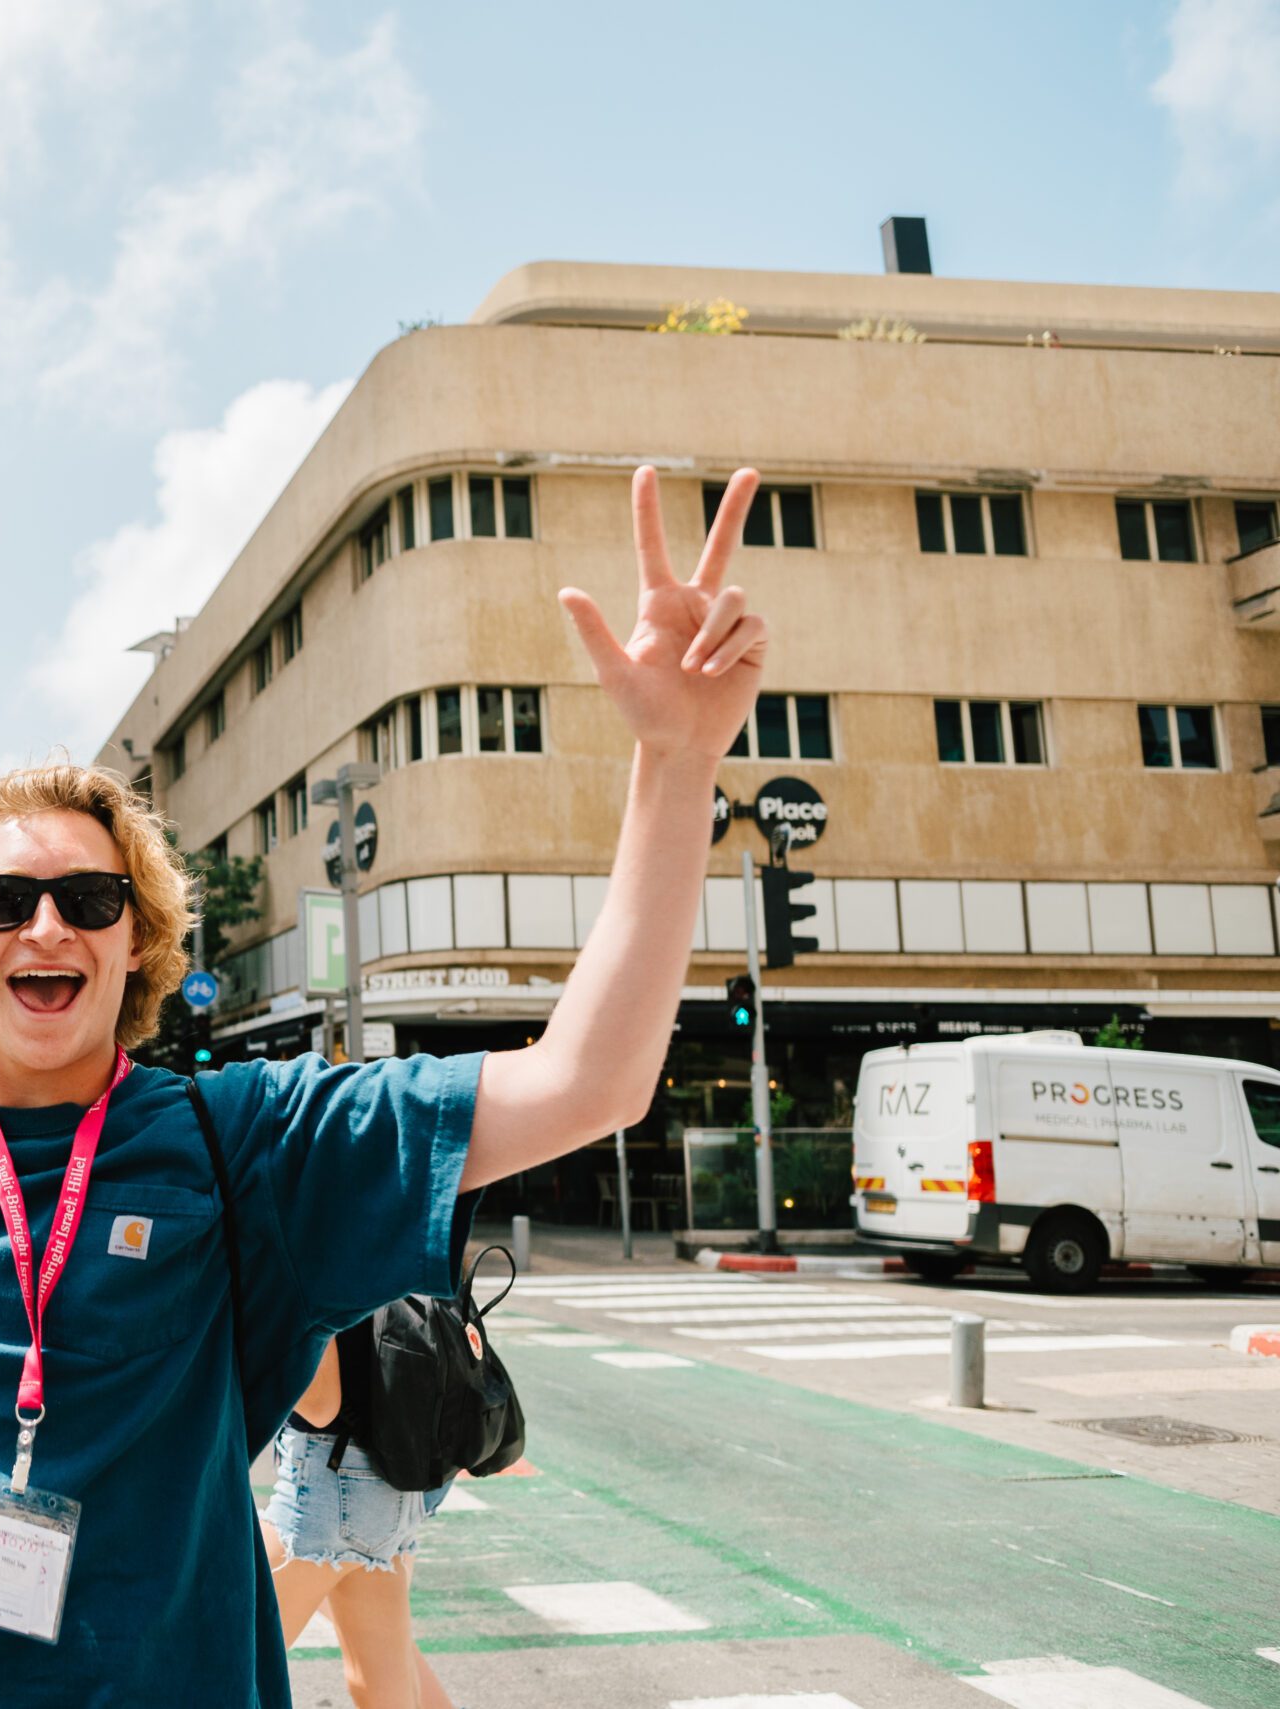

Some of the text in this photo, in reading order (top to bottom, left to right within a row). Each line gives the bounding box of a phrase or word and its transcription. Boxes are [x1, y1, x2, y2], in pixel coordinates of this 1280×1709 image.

[758, 796, 828, 821] Place
[368, 968, 447, 991] STREET
[448, 966, 510, 987] FOOD
[1031, 1080, 1184, 1112] PROGRESS
[1035, 1114, 1090, 1129] MEDICAL
[1162, 1120, 1188, 1134] LAB
[39, 1155, 87, 1304] irthright Israel: Hillel
